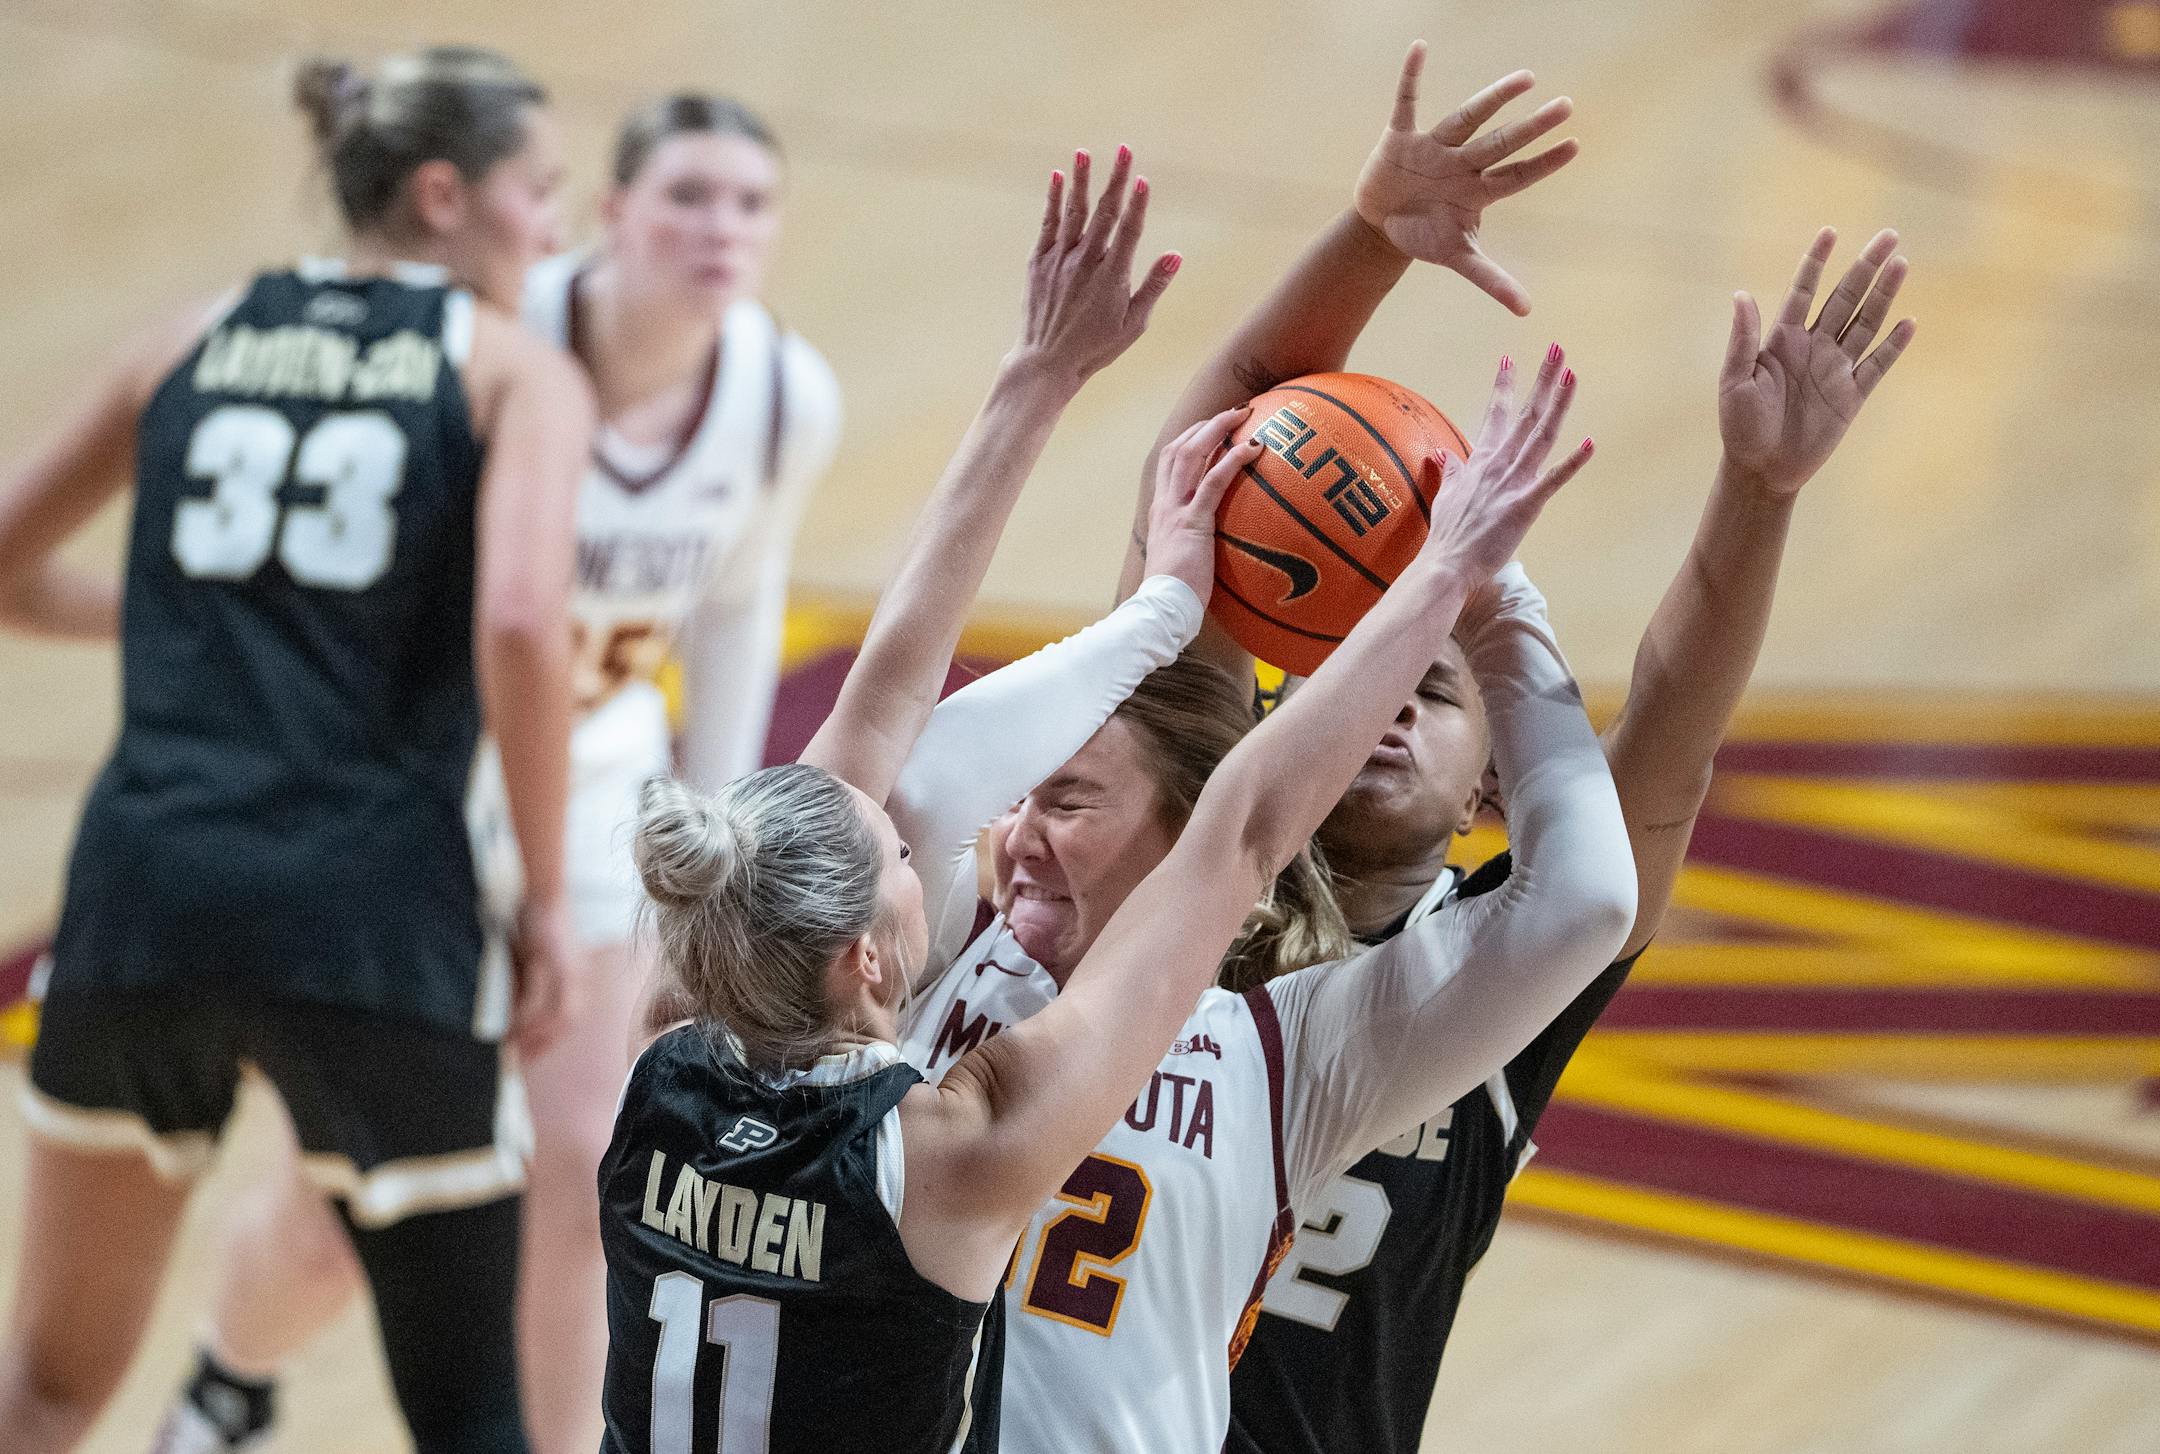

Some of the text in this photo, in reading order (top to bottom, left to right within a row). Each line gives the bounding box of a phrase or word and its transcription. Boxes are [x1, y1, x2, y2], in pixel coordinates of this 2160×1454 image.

[172, 405, 407, 592] 33
[1251, 406, 1392, 538] ELITE
[718, 1115, 778, 1151] P
[641, 1149, 827, 1282] LAYDEN
[649, 1270, 781, 1454] 11
